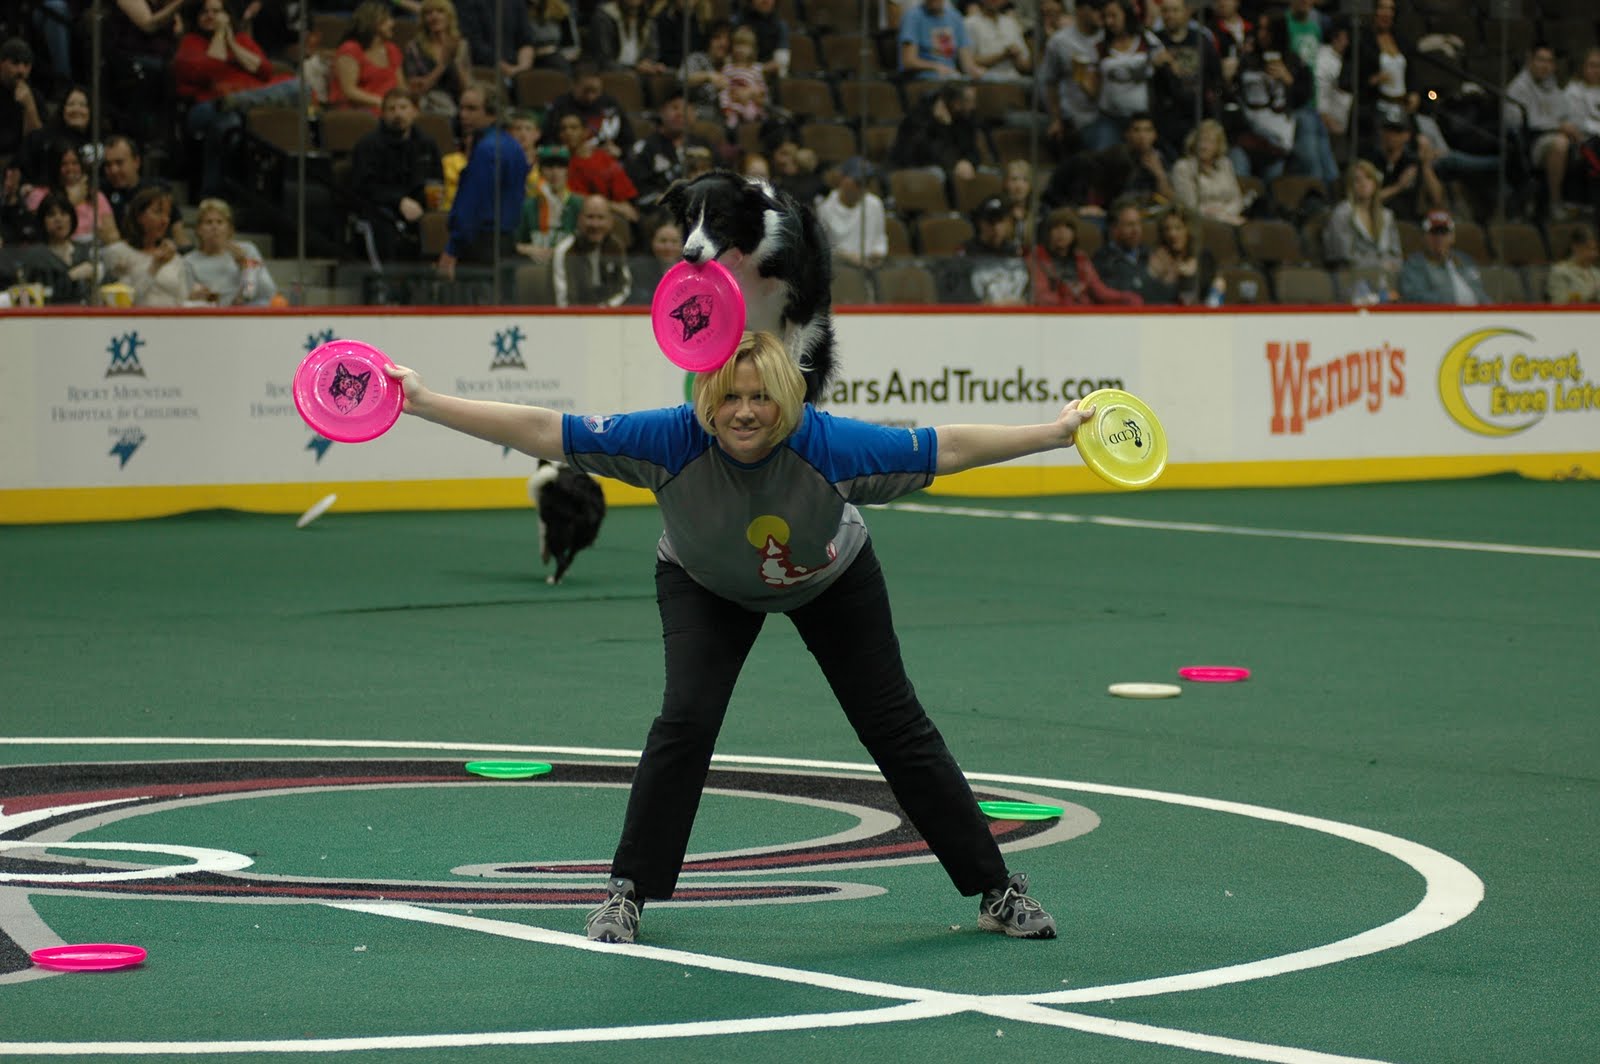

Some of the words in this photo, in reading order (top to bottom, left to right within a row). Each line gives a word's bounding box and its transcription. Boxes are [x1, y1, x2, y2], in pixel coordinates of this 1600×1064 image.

[1464, 355, 1503, 385] Eat
[823, 367, 1124, 403] arsAndTrucks.co
[1492, 386, 1546, 415] Even
[1109, 428, 1135, 445] CDD
